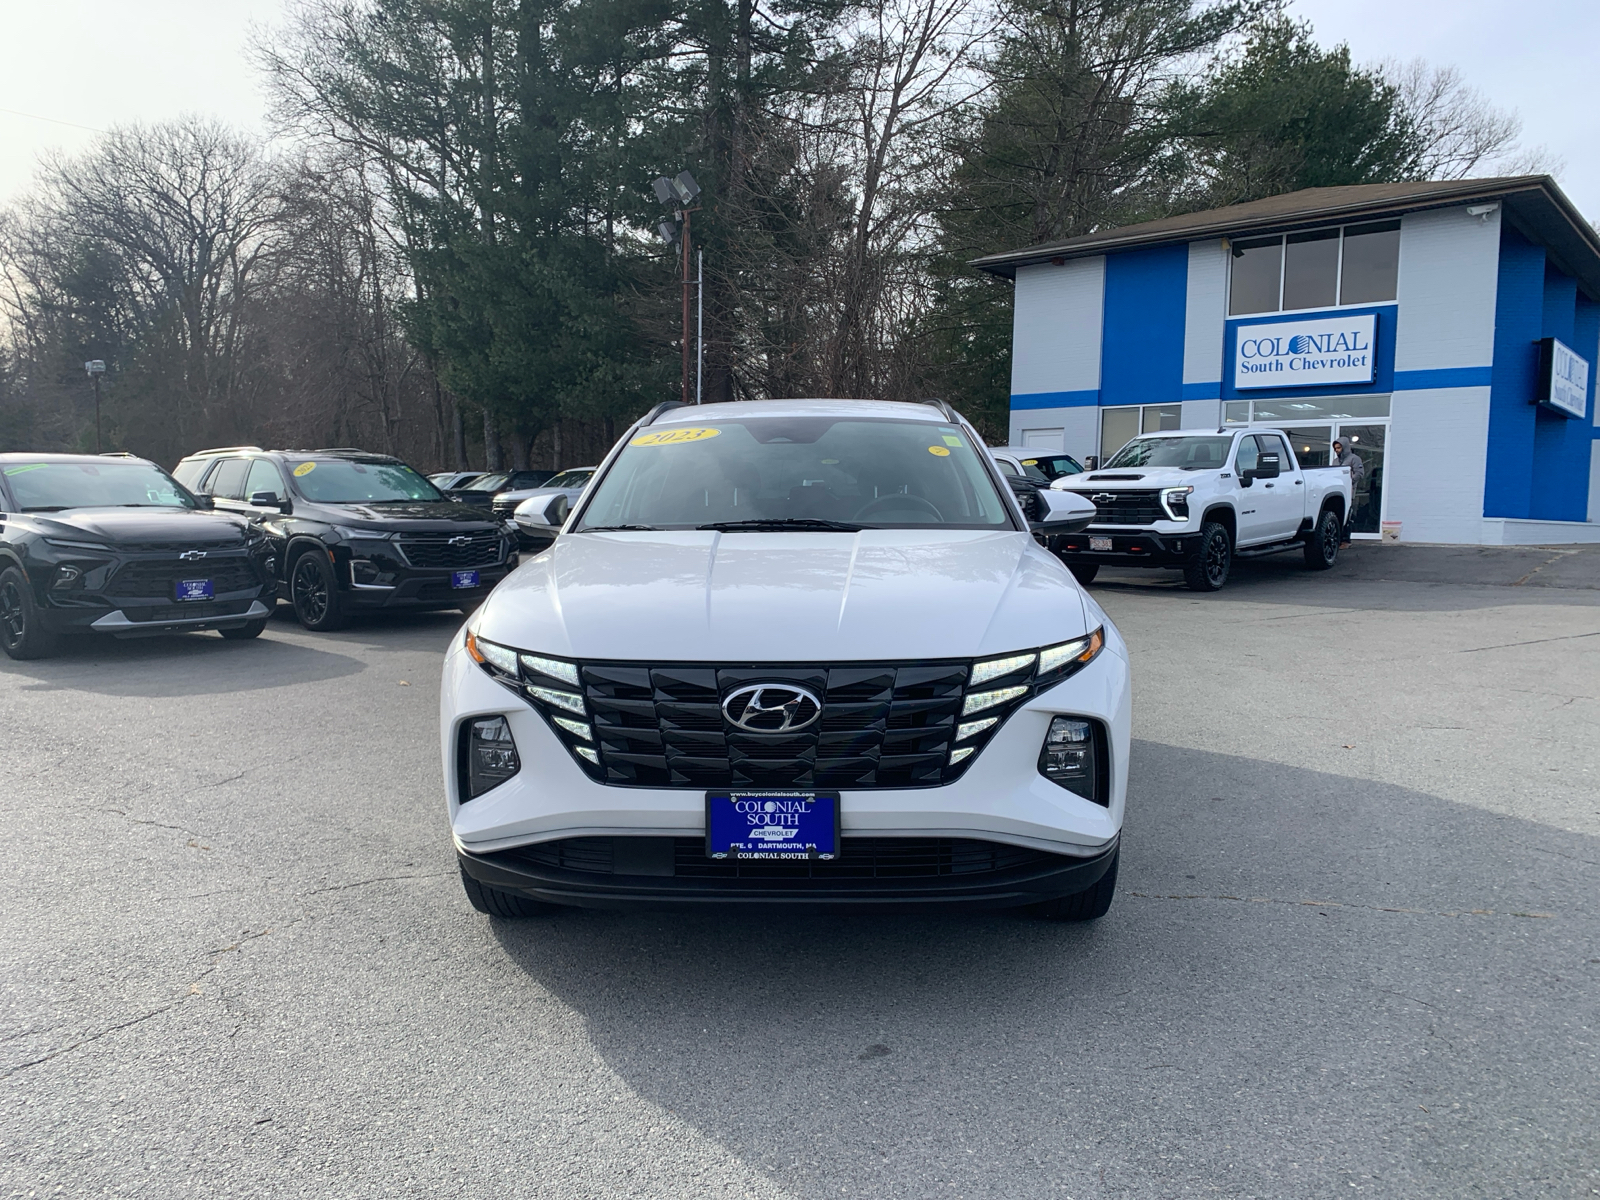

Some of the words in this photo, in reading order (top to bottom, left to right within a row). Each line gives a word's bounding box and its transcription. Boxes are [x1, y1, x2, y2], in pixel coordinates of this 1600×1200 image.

[1241, 331, 1369, 358] COLONIAL
[1241, 359, 1284, 374] South
[1289, 354, 1367, 371] Chevrolet
[642, 429, 706, 445] 2023
[735, 801, 811, 813] COLONIAL
[747, 813, 799, 825] SOUTH
[780, 852, 809, 860] SOUTH
